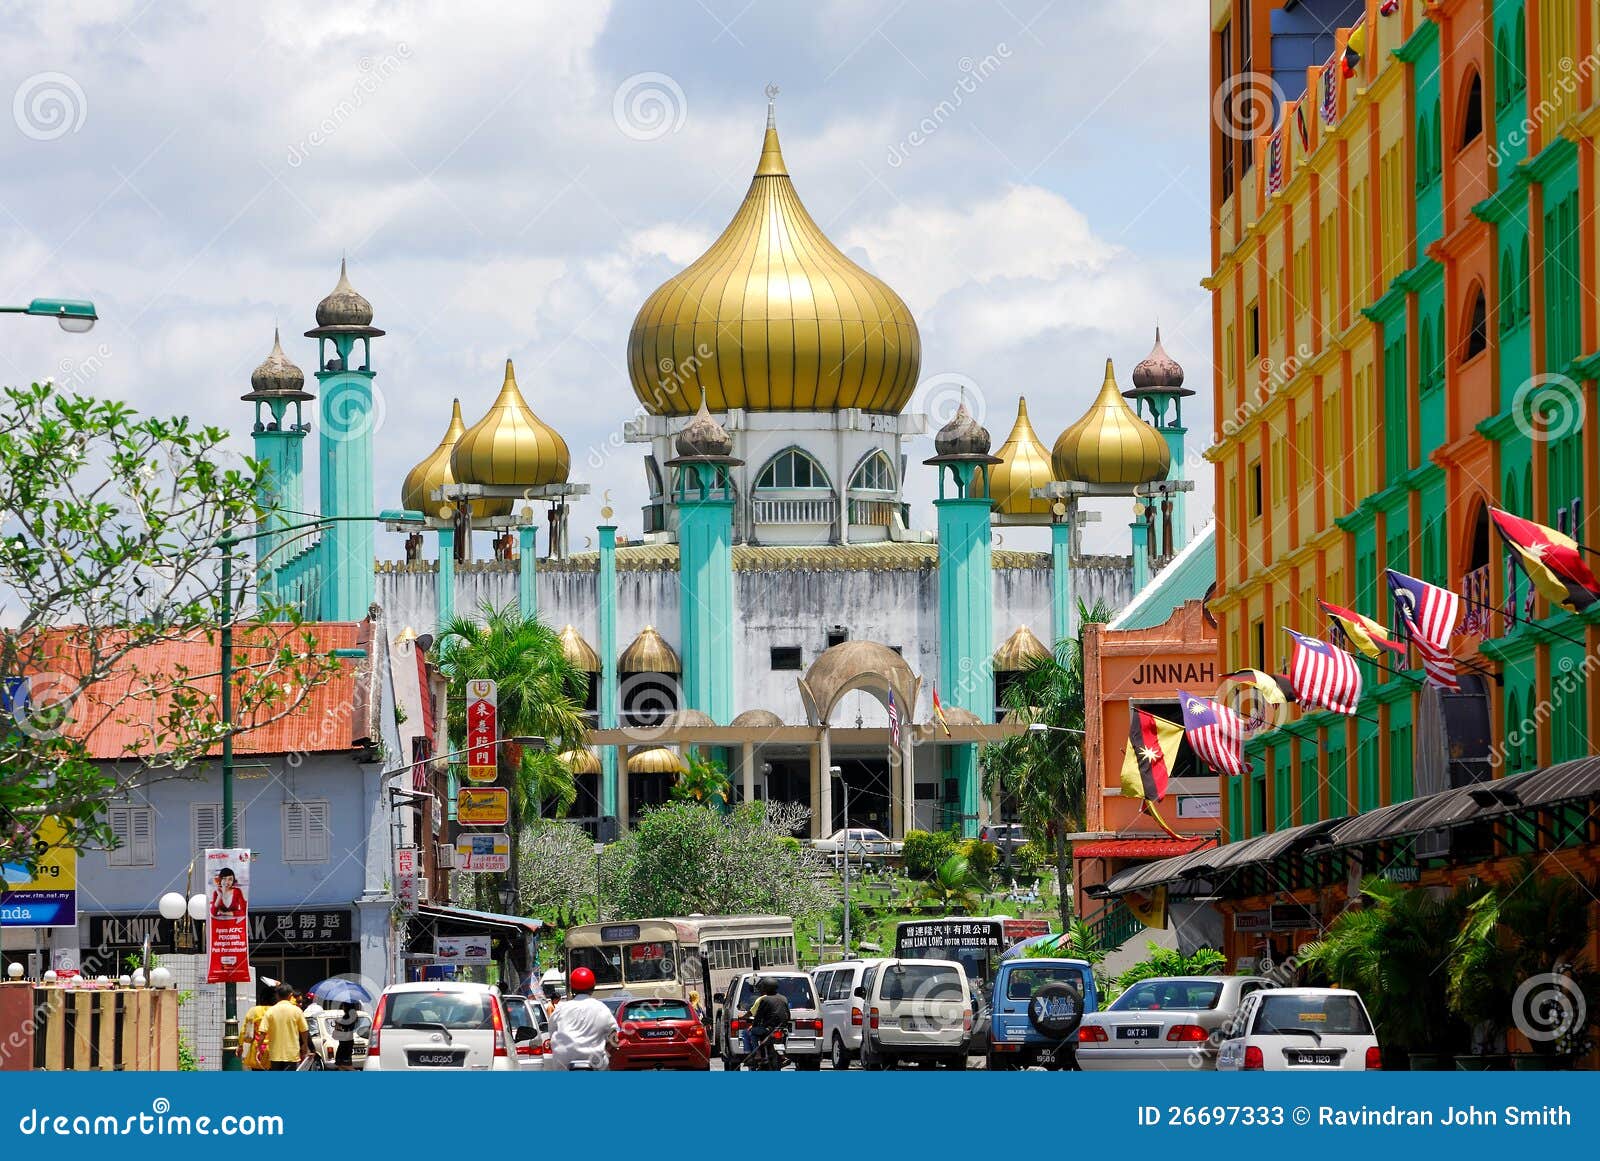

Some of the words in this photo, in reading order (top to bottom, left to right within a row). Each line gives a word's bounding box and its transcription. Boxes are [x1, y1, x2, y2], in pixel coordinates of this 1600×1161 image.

[1132, 662, 1214, 685] JINNAH
[102, 918, 161, 944] KLINIK
[914, 937, 928, 947] LIAN
[928, 936, 943, 946] LONG
[944, 938, 960, 946] MOTOR
[961, 938, 979, 946] VEHICLE
